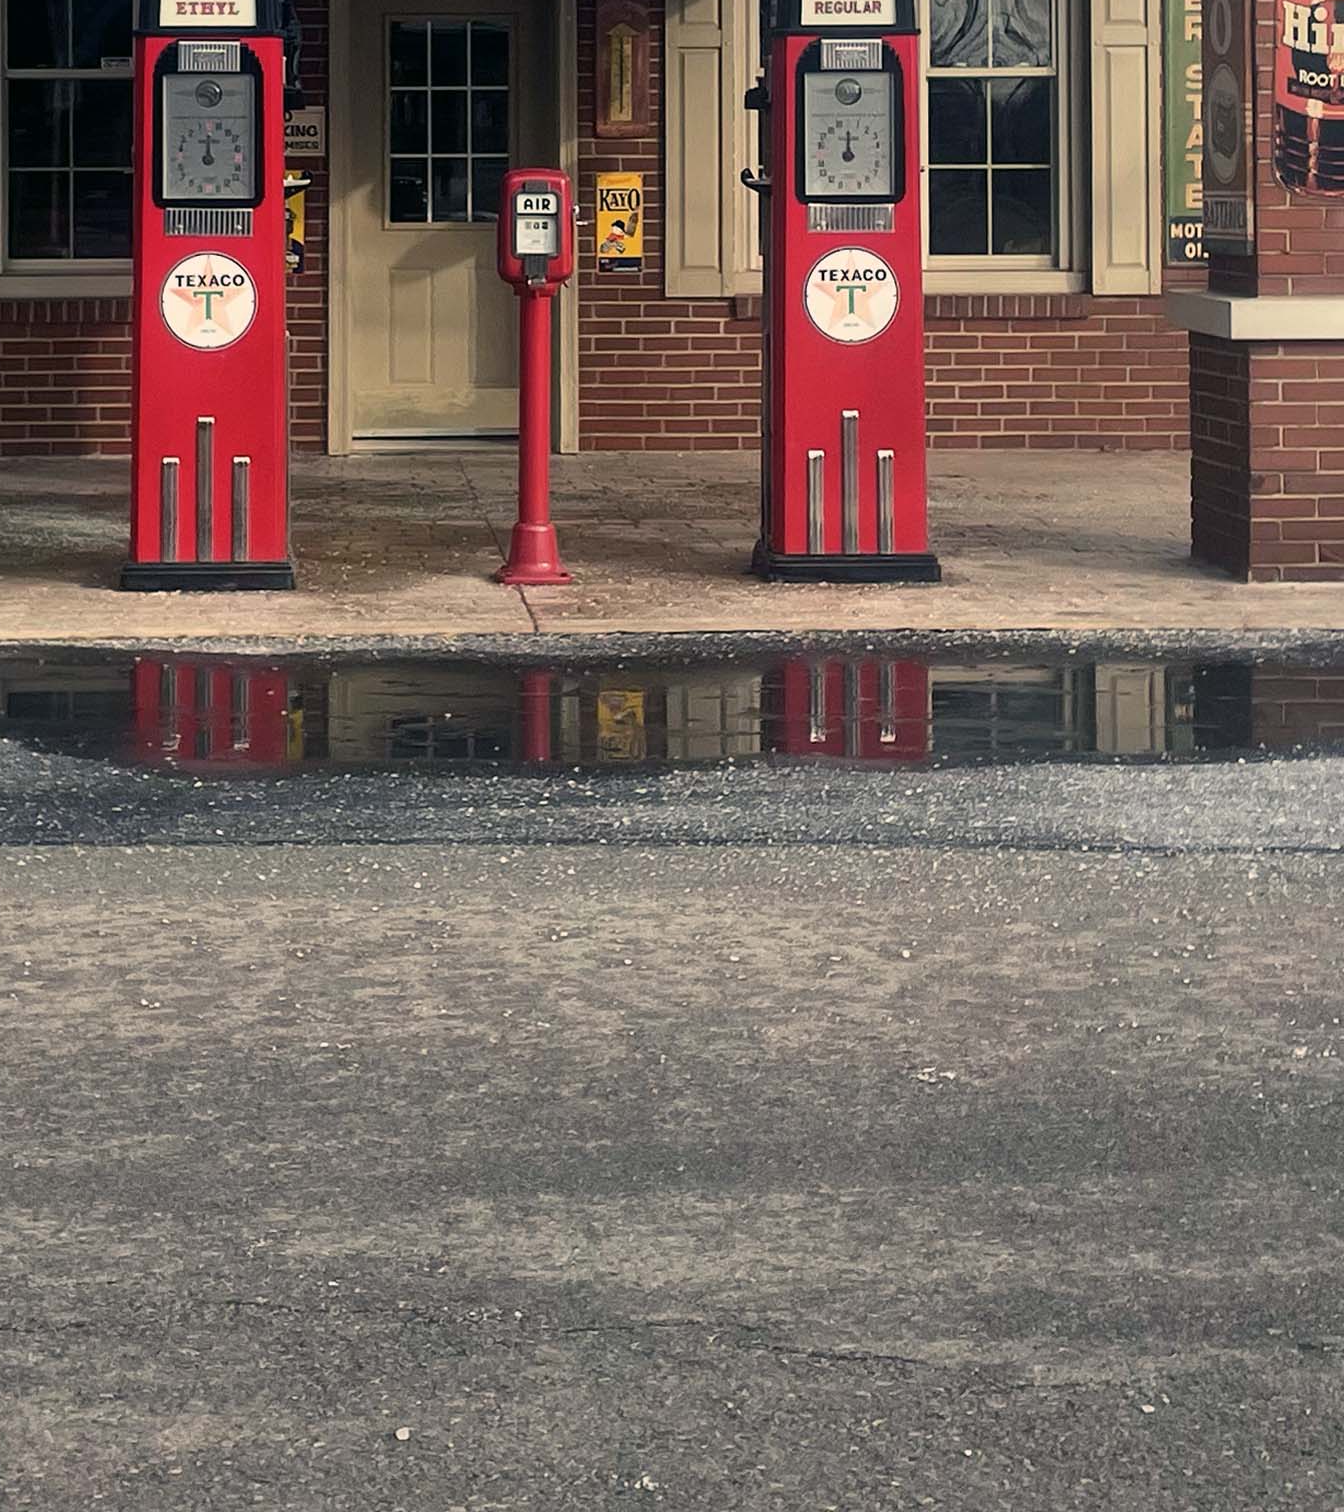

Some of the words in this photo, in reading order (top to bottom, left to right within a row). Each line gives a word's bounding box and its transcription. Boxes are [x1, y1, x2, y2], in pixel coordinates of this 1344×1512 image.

[176, 1, 240, 16] ETHYL
[814, 0, 882, 15] REGULAR
[1299, 69, 1337, 87] ROOT
[523, 198, 551, 210] AIR
[599, 188, 641, 212] KAYO
[1170, 223, 1204, 238] MOT
[175, 274, 245, 288] TEXACO
[818, 269, 887, 282] TEXACO
